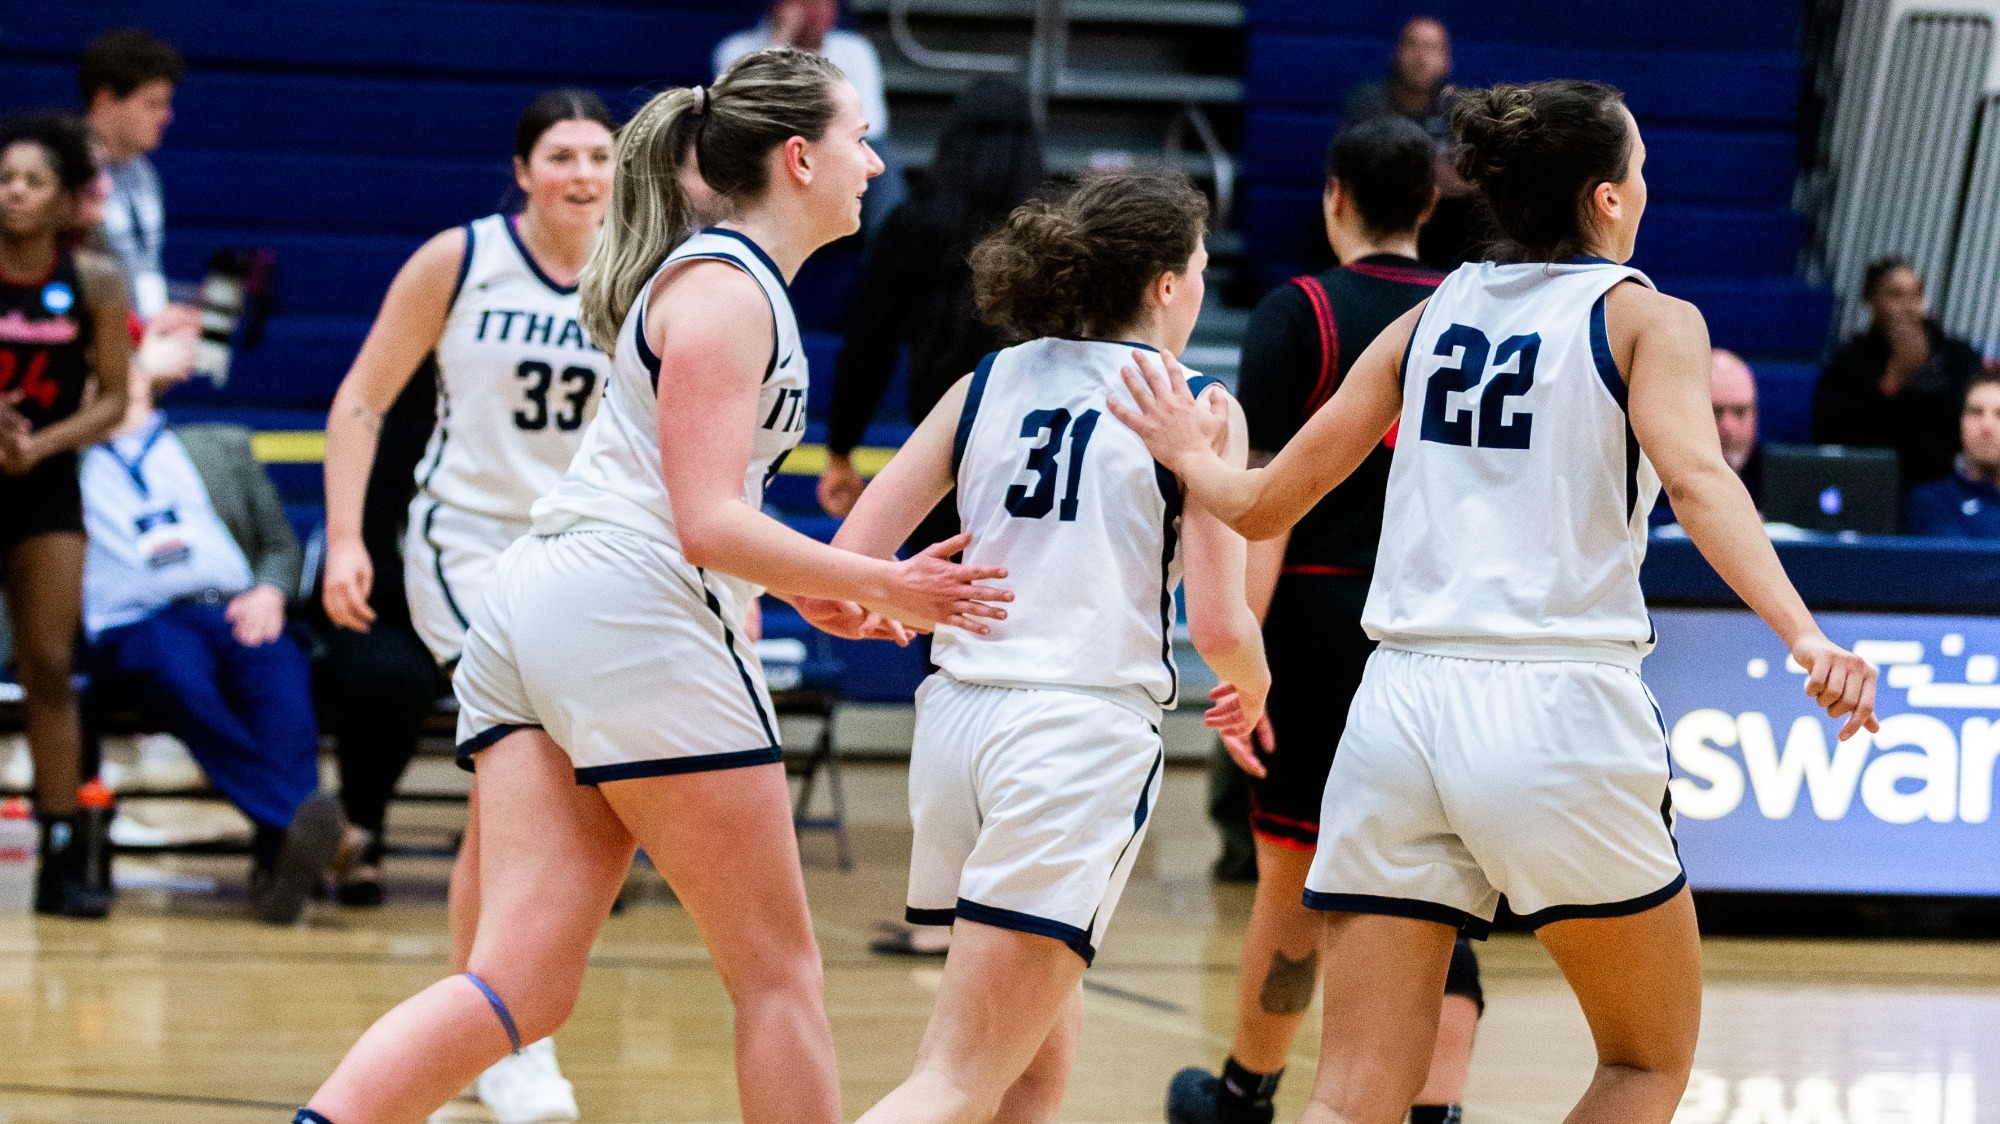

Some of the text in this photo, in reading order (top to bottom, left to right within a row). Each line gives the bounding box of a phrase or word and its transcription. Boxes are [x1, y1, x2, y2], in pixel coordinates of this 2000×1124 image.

[475, 309, 604, 353] ITHA
[514, 360, 596, 430] 33
[1420, 323, 1542, 450] 22
[1004, 407, 1102, 522] 31
